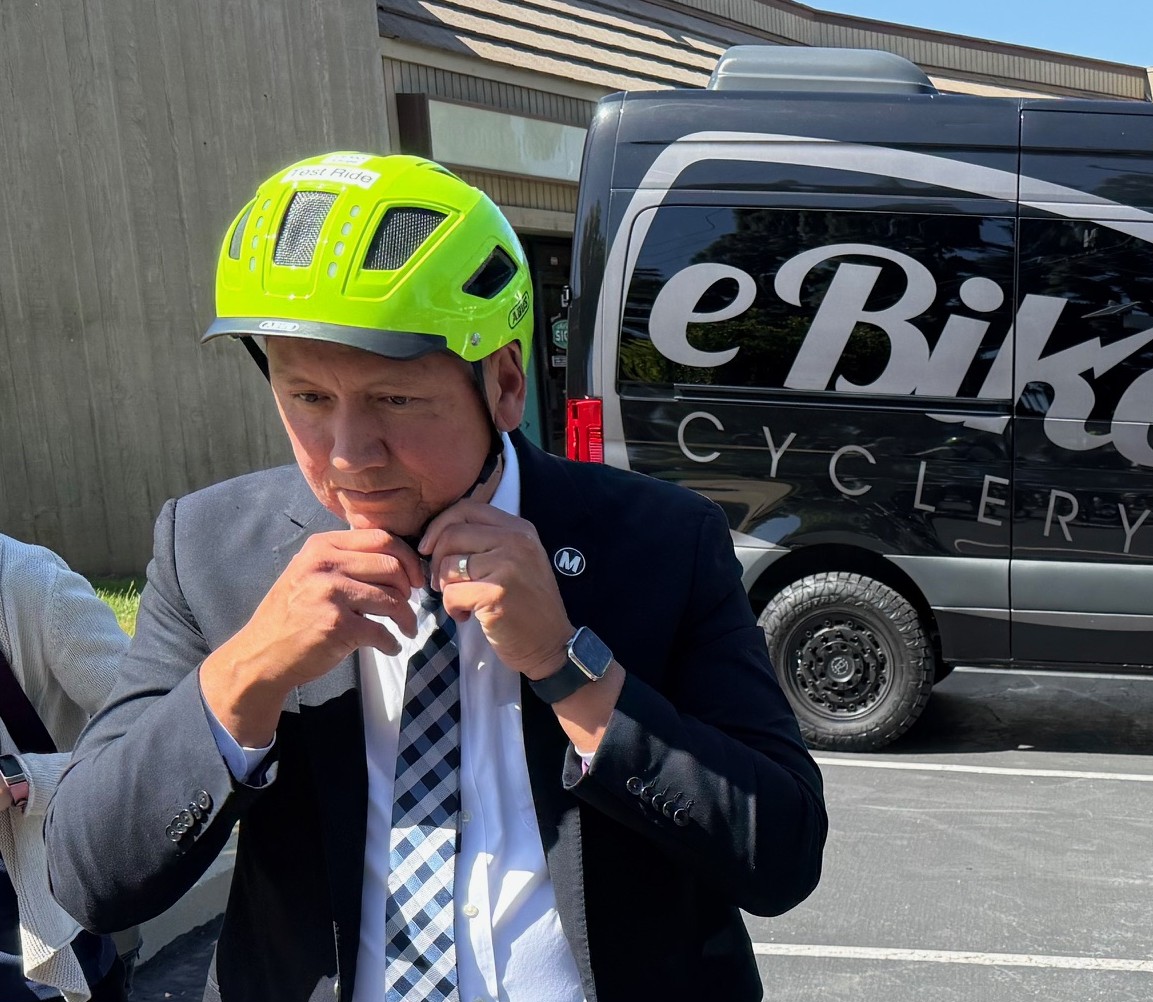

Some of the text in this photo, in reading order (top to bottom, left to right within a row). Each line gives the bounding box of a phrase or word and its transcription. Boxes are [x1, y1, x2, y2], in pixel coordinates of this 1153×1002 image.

[330, 167, 373, 183] Ride
[512, 296, 528, 325] ABUS
[677, 410, 1152, 555] CYCLERY
